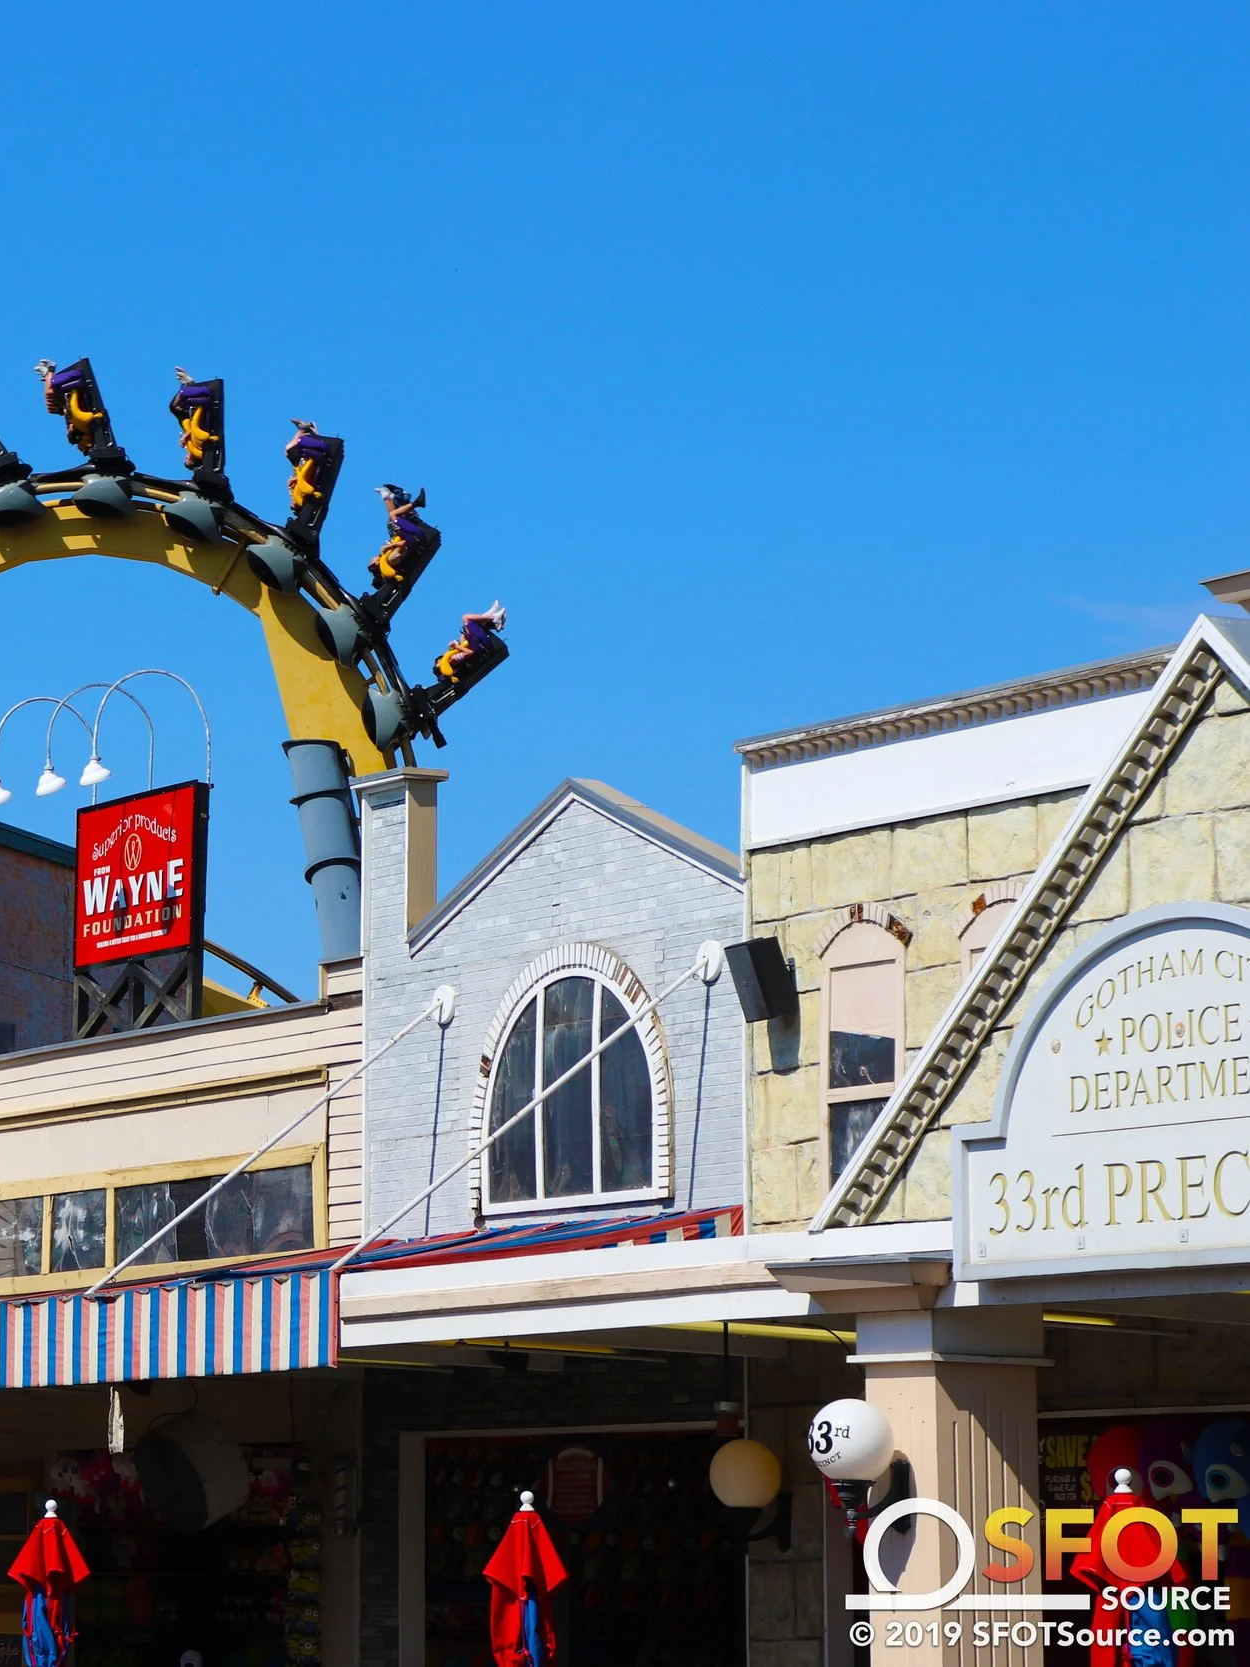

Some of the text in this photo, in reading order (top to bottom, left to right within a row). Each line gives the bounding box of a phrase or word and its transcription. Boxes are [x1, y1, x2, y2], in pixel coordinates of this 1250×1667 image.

[92, 813, 177, 861] Superior products
[83, 858, 184, 916] WAYNE
[93, 865, 111, 877] FROM
[83, 903, 182, 938] FOUNDATION
[1076, 948, 1205, 1031] GOTHAM
[1121, 1002, 1243, 1056] POLICE
[989, 1149, 1250, 1236] 33rd PREC
[1045, 1435, 1089, 1468] SAVE
